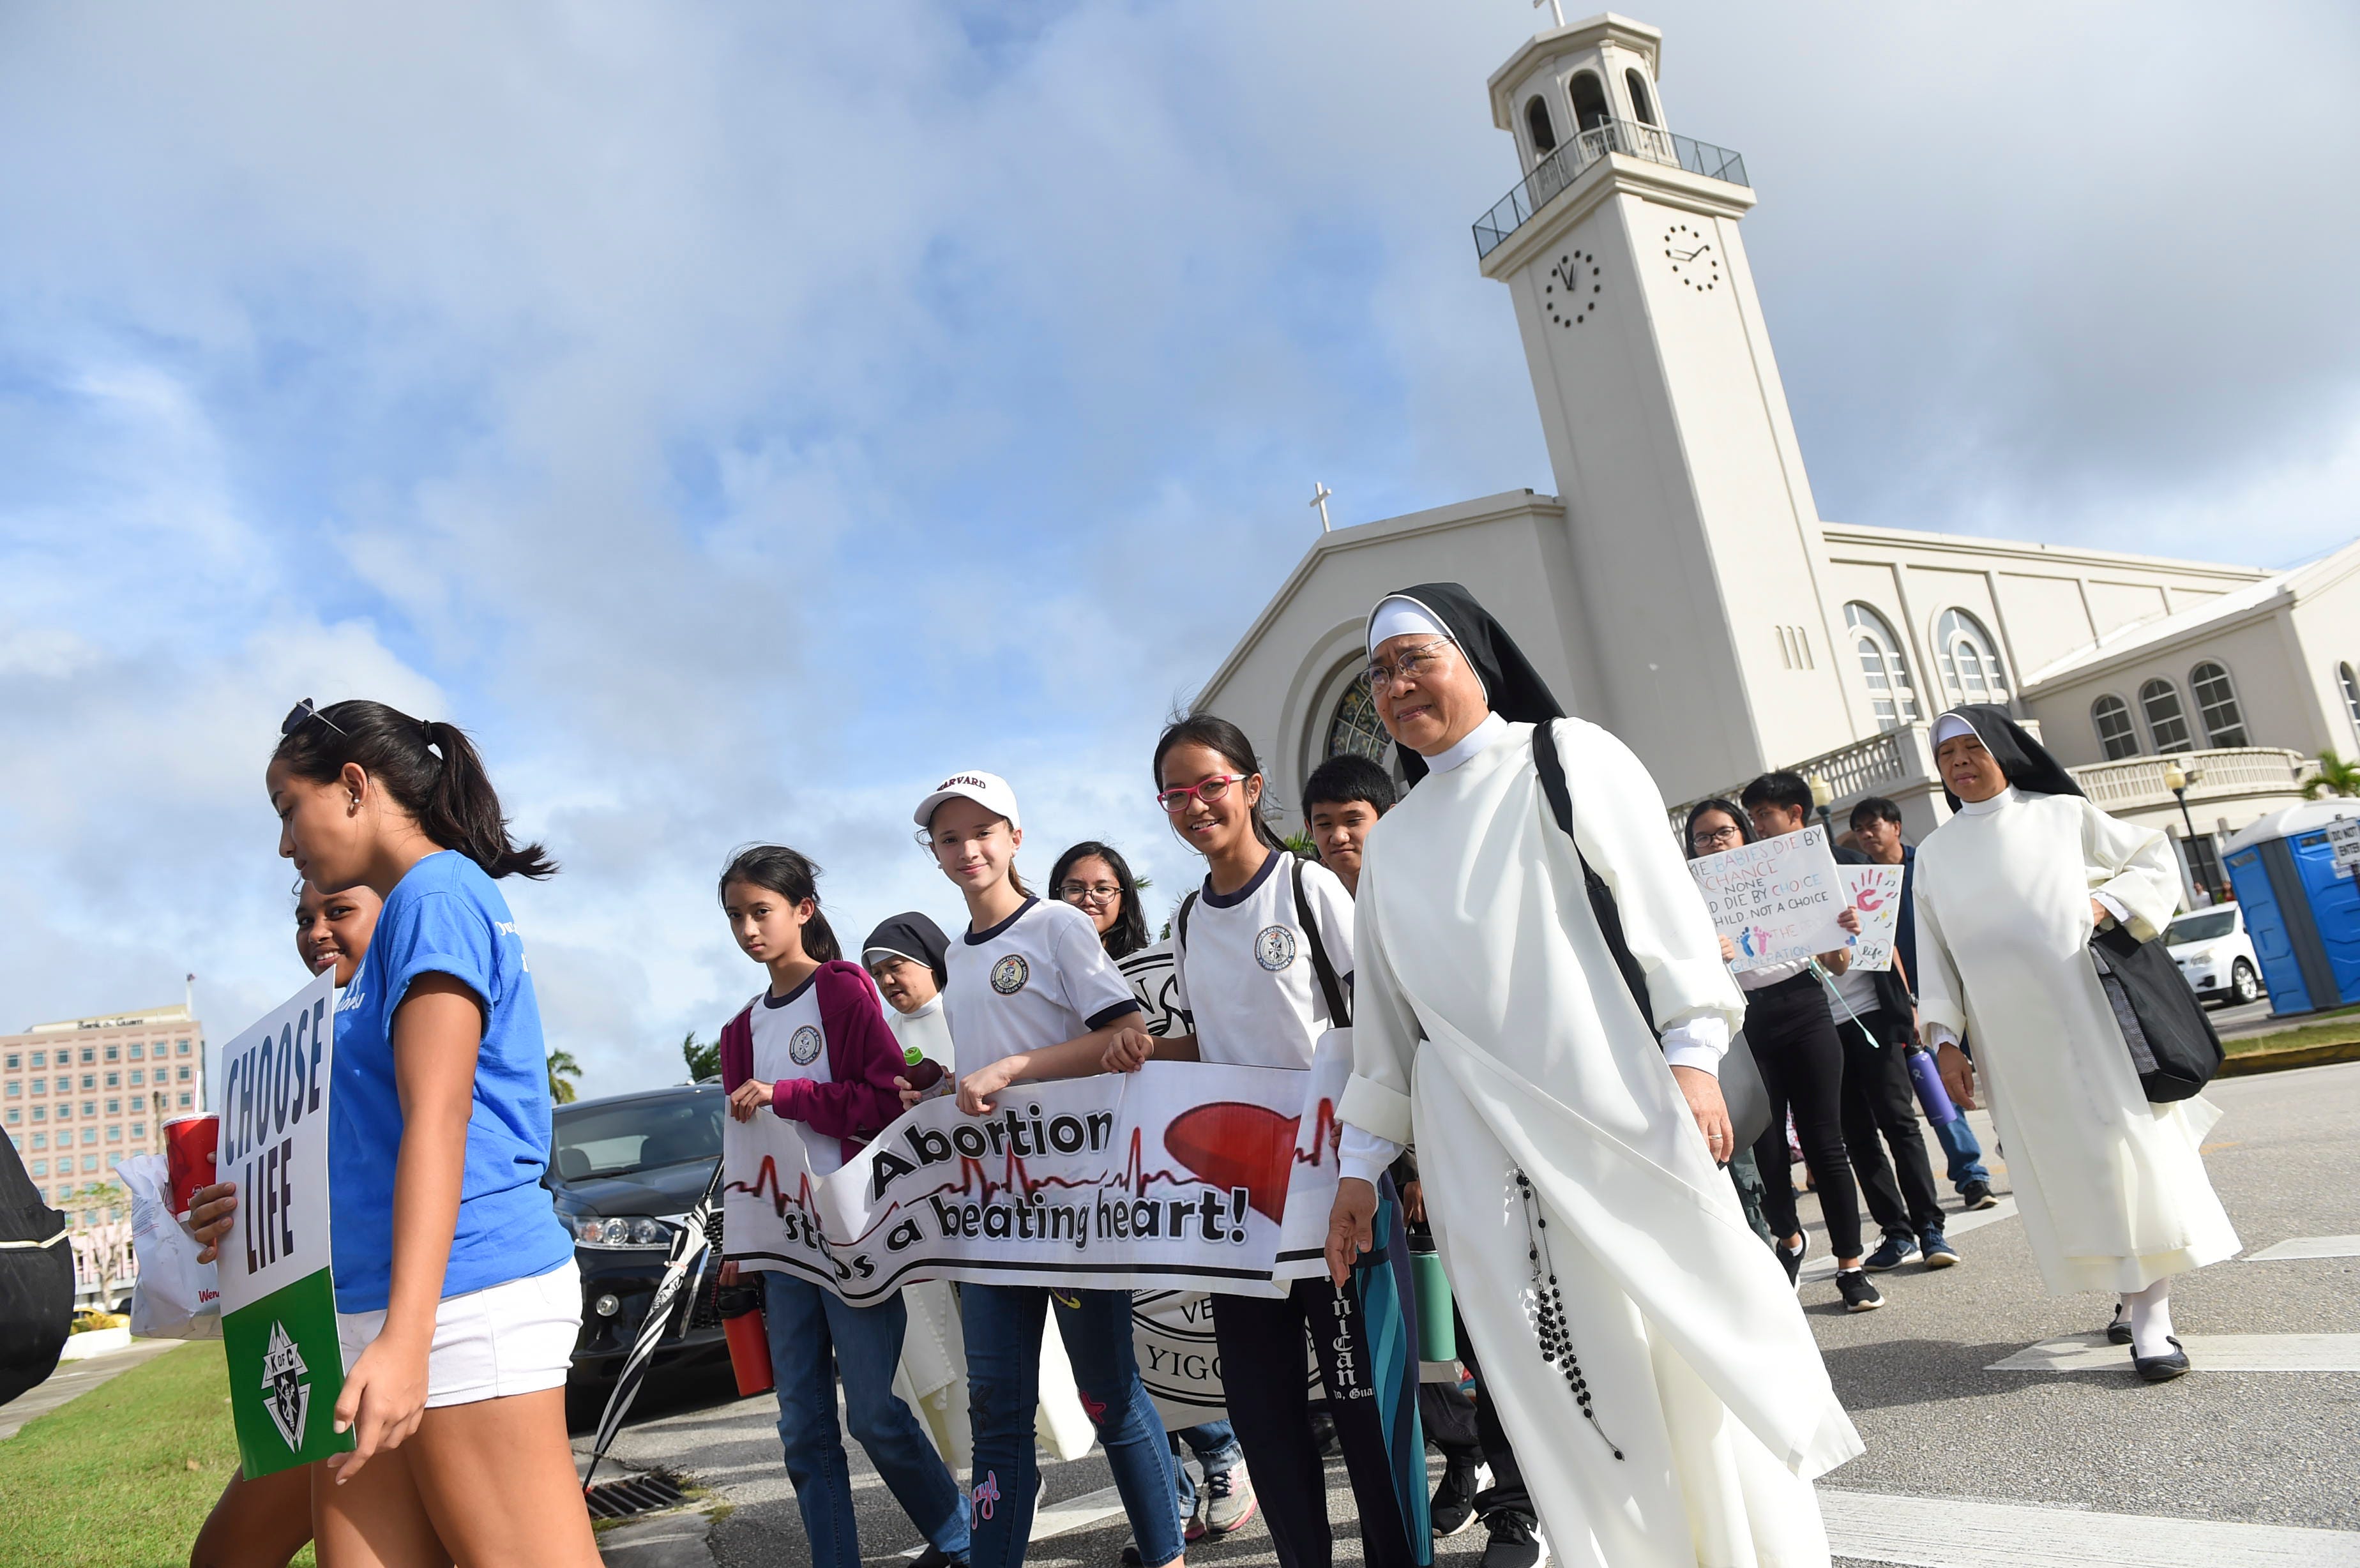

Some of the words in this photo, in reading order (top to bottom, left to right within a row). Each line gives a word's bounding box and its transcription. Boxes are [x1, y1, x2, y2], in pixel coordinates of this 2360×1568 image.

[2343, 825, 2357, 838] NOT
[1714, 845, 1768, 872] BABIES
[1773, 837, 1799, 854] DIE
[1804, 829, 1821, 847] BY
[1706, 859, 1778, 890] CHANCE
[1725, 878, 1764, 894] NONE
[1724, 894, 1748, 910] DIE
[1751, 888, 1767, 904] BY
[1772, 873, 1822, 896] CHOICE
[1713, 912, 1749, 928] HILD.
[1750, 904, 1773, 919] NOT
[1777, 902, 1785, 913] A
[1789, 891, 1829, 910] CHOICE
[1770, 924, 1799, 940] THE
[1731, 945, 1812, 972] GENERATION
[1862, 946, 1883, 960] life
[225, 997, 324, 1166] CHOOSE
[872, 1104, 1113, 1202] Abortion
[245, 1137, 294, 1275] LIFE
[887, 1218, 923, 1251] a
[929, 1193, 1088, 1249] beating
[1097, 1187, 1248, 1242] heart!
[198, 1288, 220, 1303] Wen
[270, 1354, 278, 1373] K
[277, 1353, 285, 1367] OF
[286, 1348, 294, 1366] C
[1349, 1388, 1374, 1399] Gua
